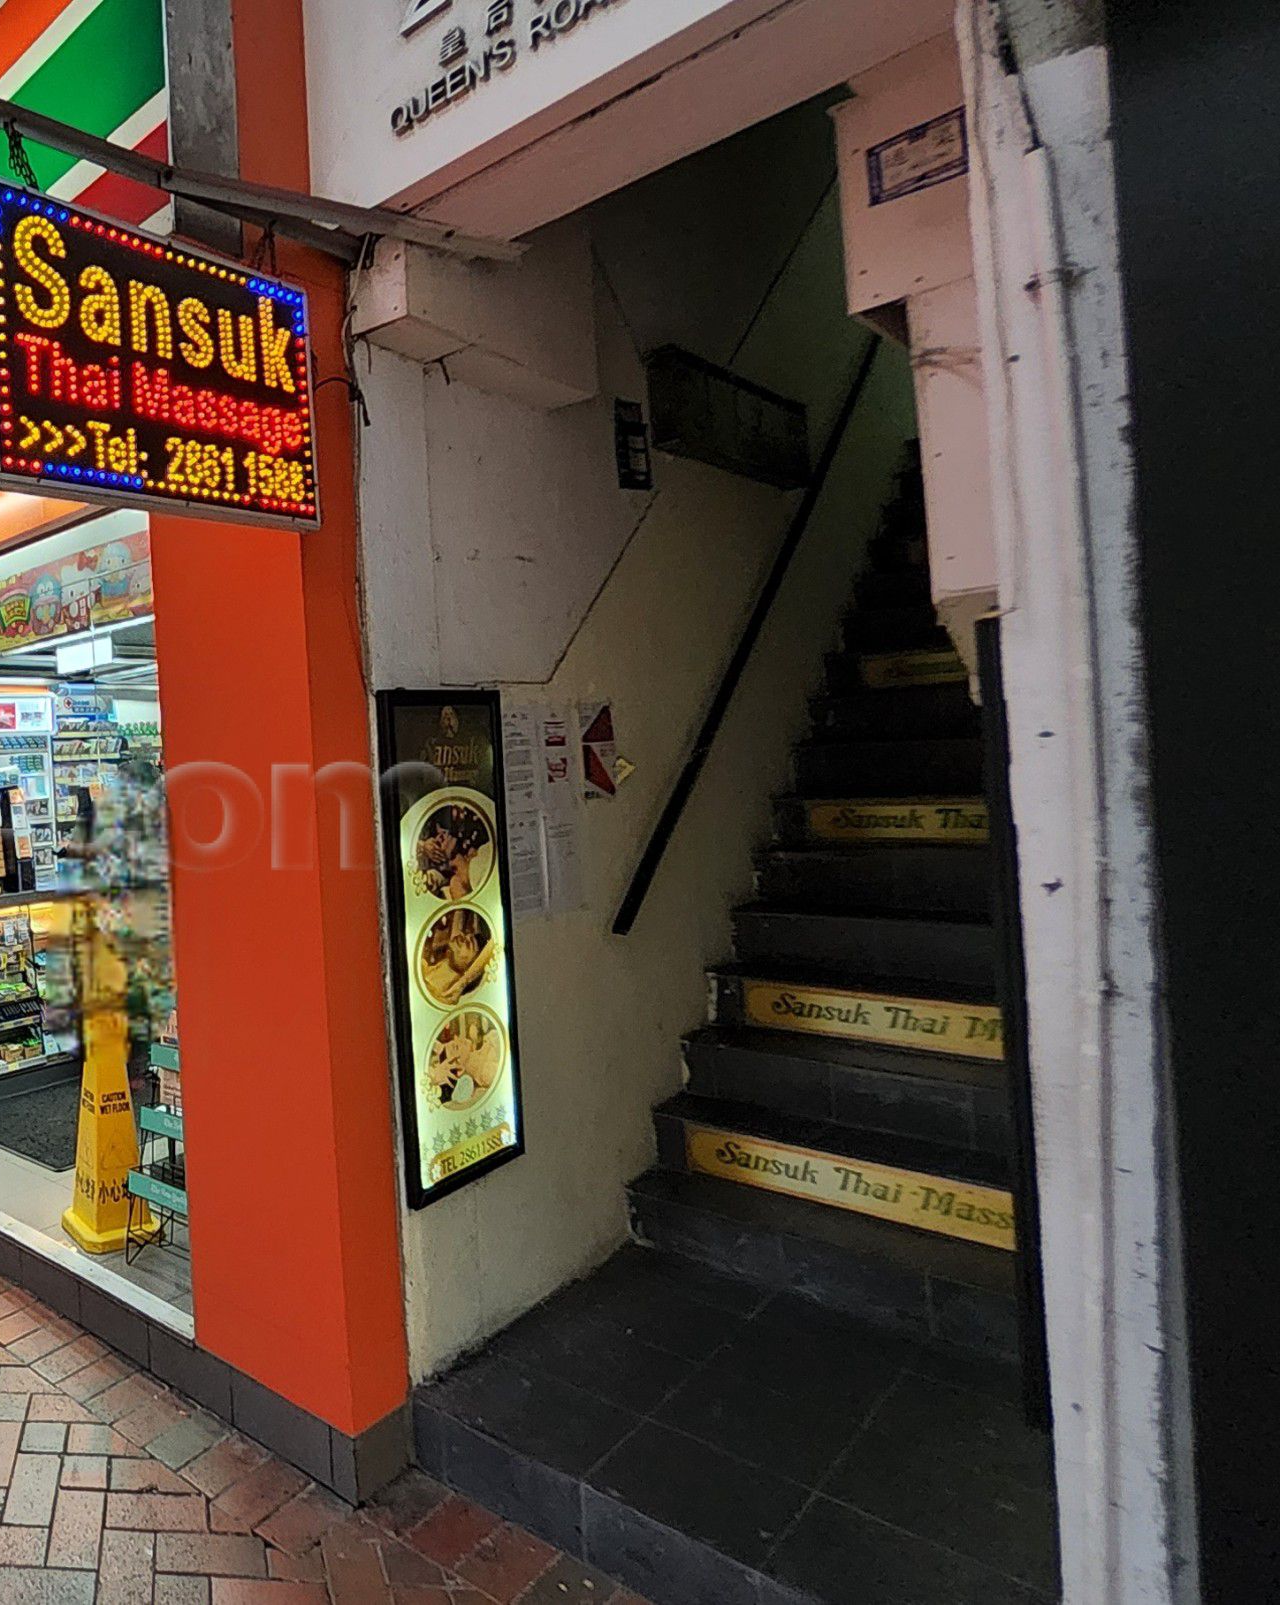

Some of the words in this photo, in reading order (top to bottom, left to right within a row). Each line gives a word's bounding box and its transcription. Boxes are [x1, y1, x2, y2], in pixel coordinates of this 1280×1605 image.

[391, 38, 517, 135] QUEEN'S
[528, 0, 630, 50] RO
[11, 214, 297, 394] Sansuk
[14, 331, 121, 409] Thai
[129, 360, 305, 456] Massage
[831, 804, 926, 832] Sansuk
[771, 992, 871, 1030] Sansuk
[882, 1004, 950, 1038] Thai
[99, 1104, 113, 1115] WET
[101, 1091, 126, 1104] CAUTION
[441, 1156, 458, 1175] TEL
[715, 1140, 819, 1186] Sansuk
[833, 1165, 904, 1205] Thai
